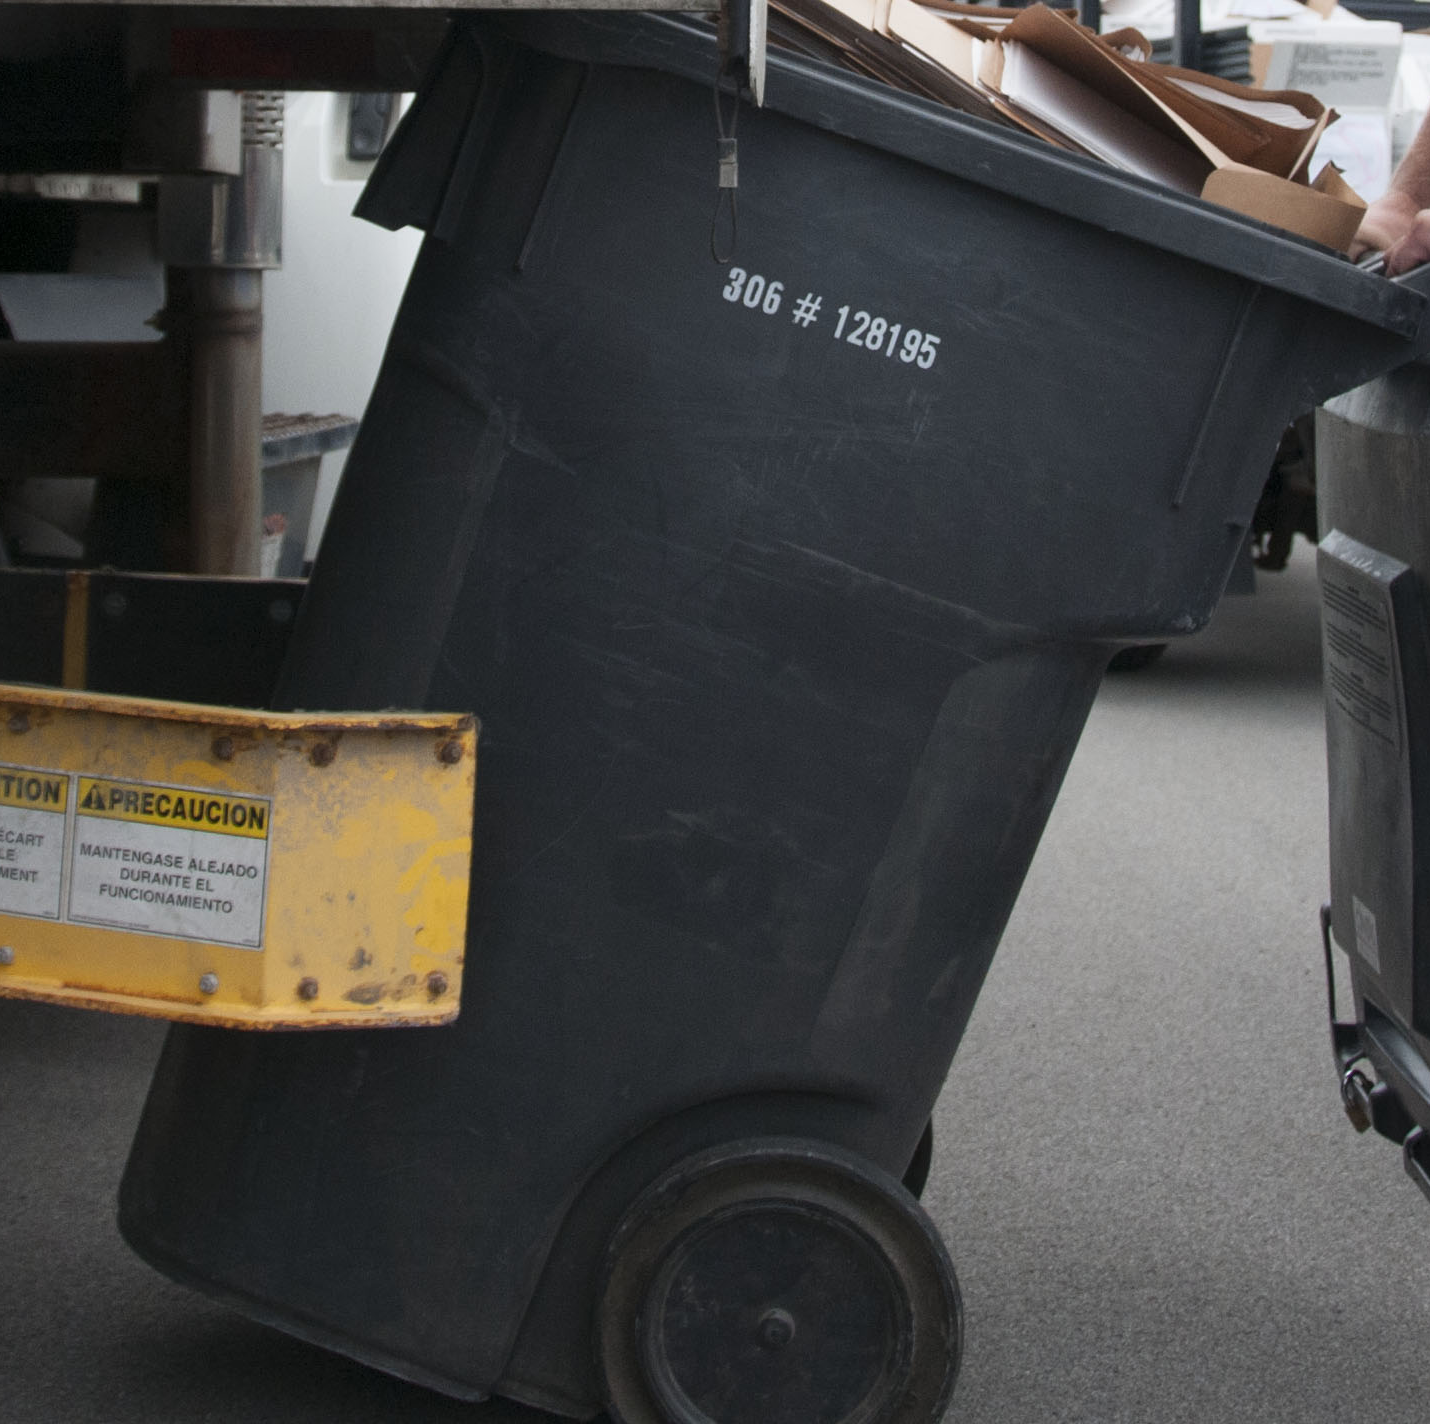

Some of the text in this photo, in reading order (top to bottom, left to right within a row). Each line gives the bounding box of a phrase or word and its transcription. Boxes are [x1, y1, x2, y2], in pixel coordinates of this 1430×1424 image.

[722, 267, 942, 369] 306 # 128195
[108, 788, 265, 830] PRECAUCION
[79, 842, 258, 880] MANTENGASE ALEJADO
[119, 867, 215, 893] DURANTE EL
[99, 883, 233, 914] FUNCIONAMIENTO
